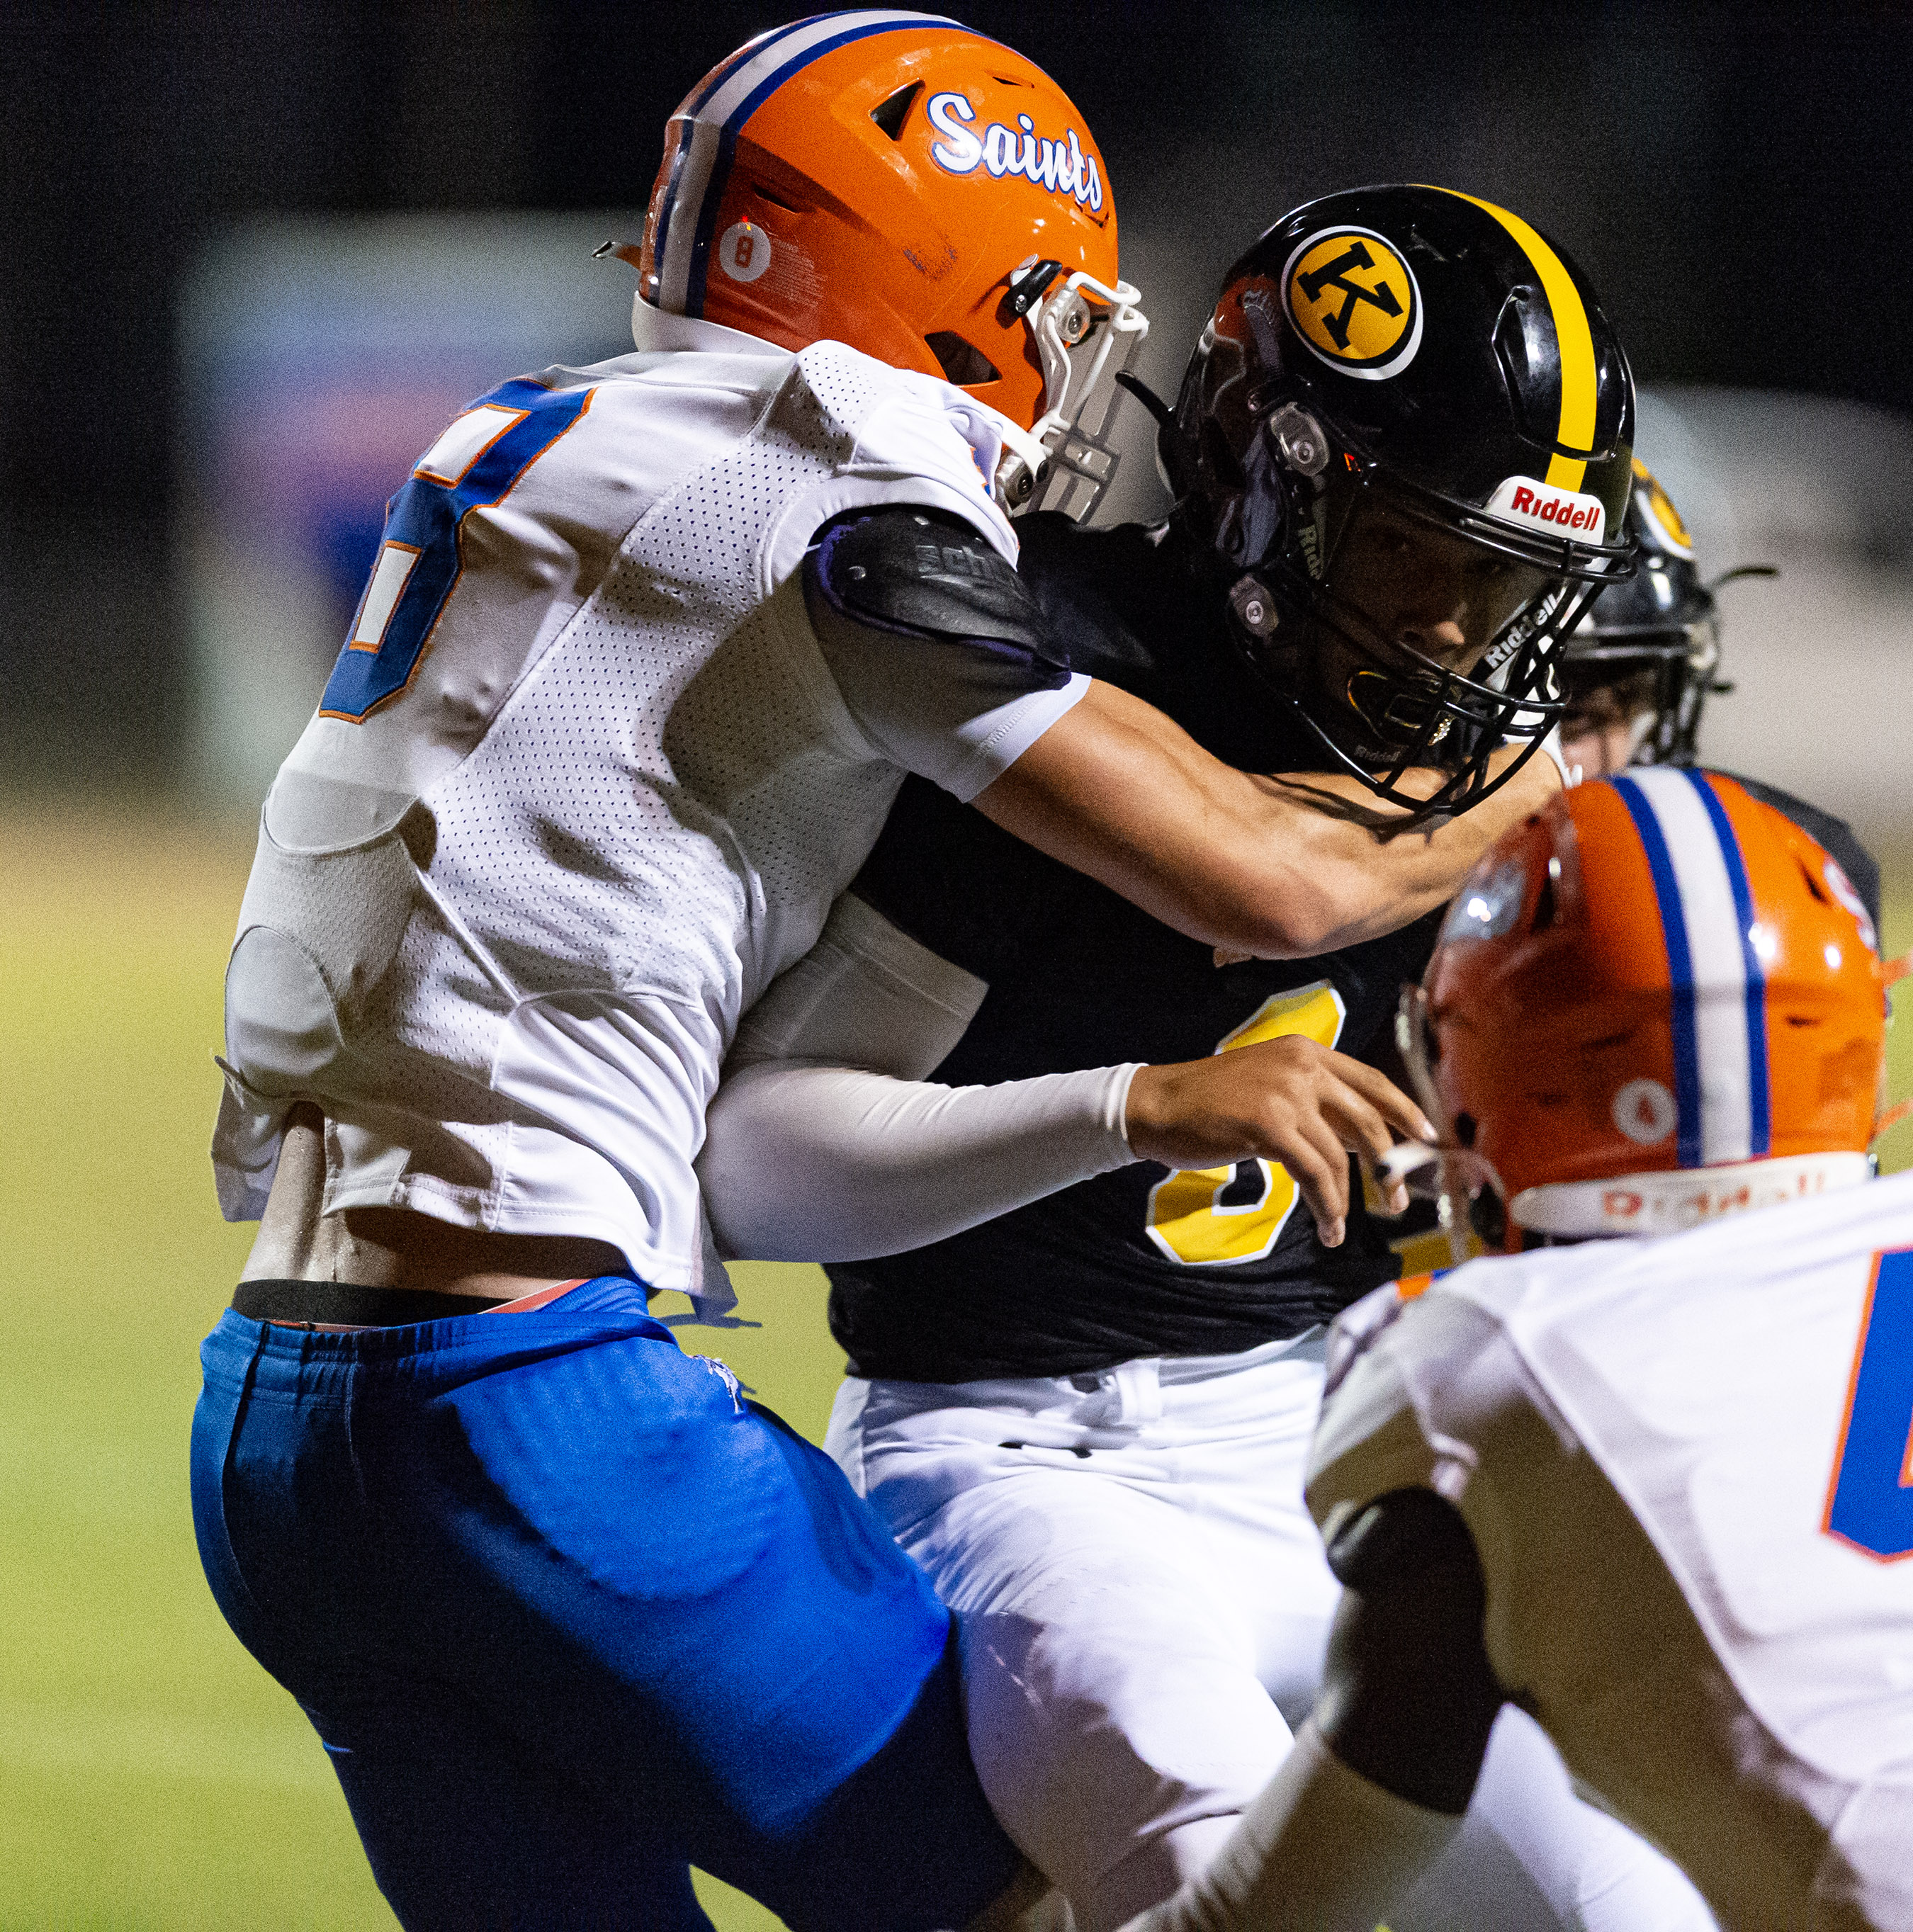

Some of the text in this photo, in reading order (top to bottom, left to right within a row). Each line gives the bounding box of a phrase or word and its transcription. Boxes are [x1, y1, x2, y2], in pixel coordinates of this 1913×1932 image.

[927, 91, 1102, 212] Saints
[735, 235, 754, 269] 8
[1297, 241, 1404, 351] K
[1512, 486, 1600, 531] Riddell
